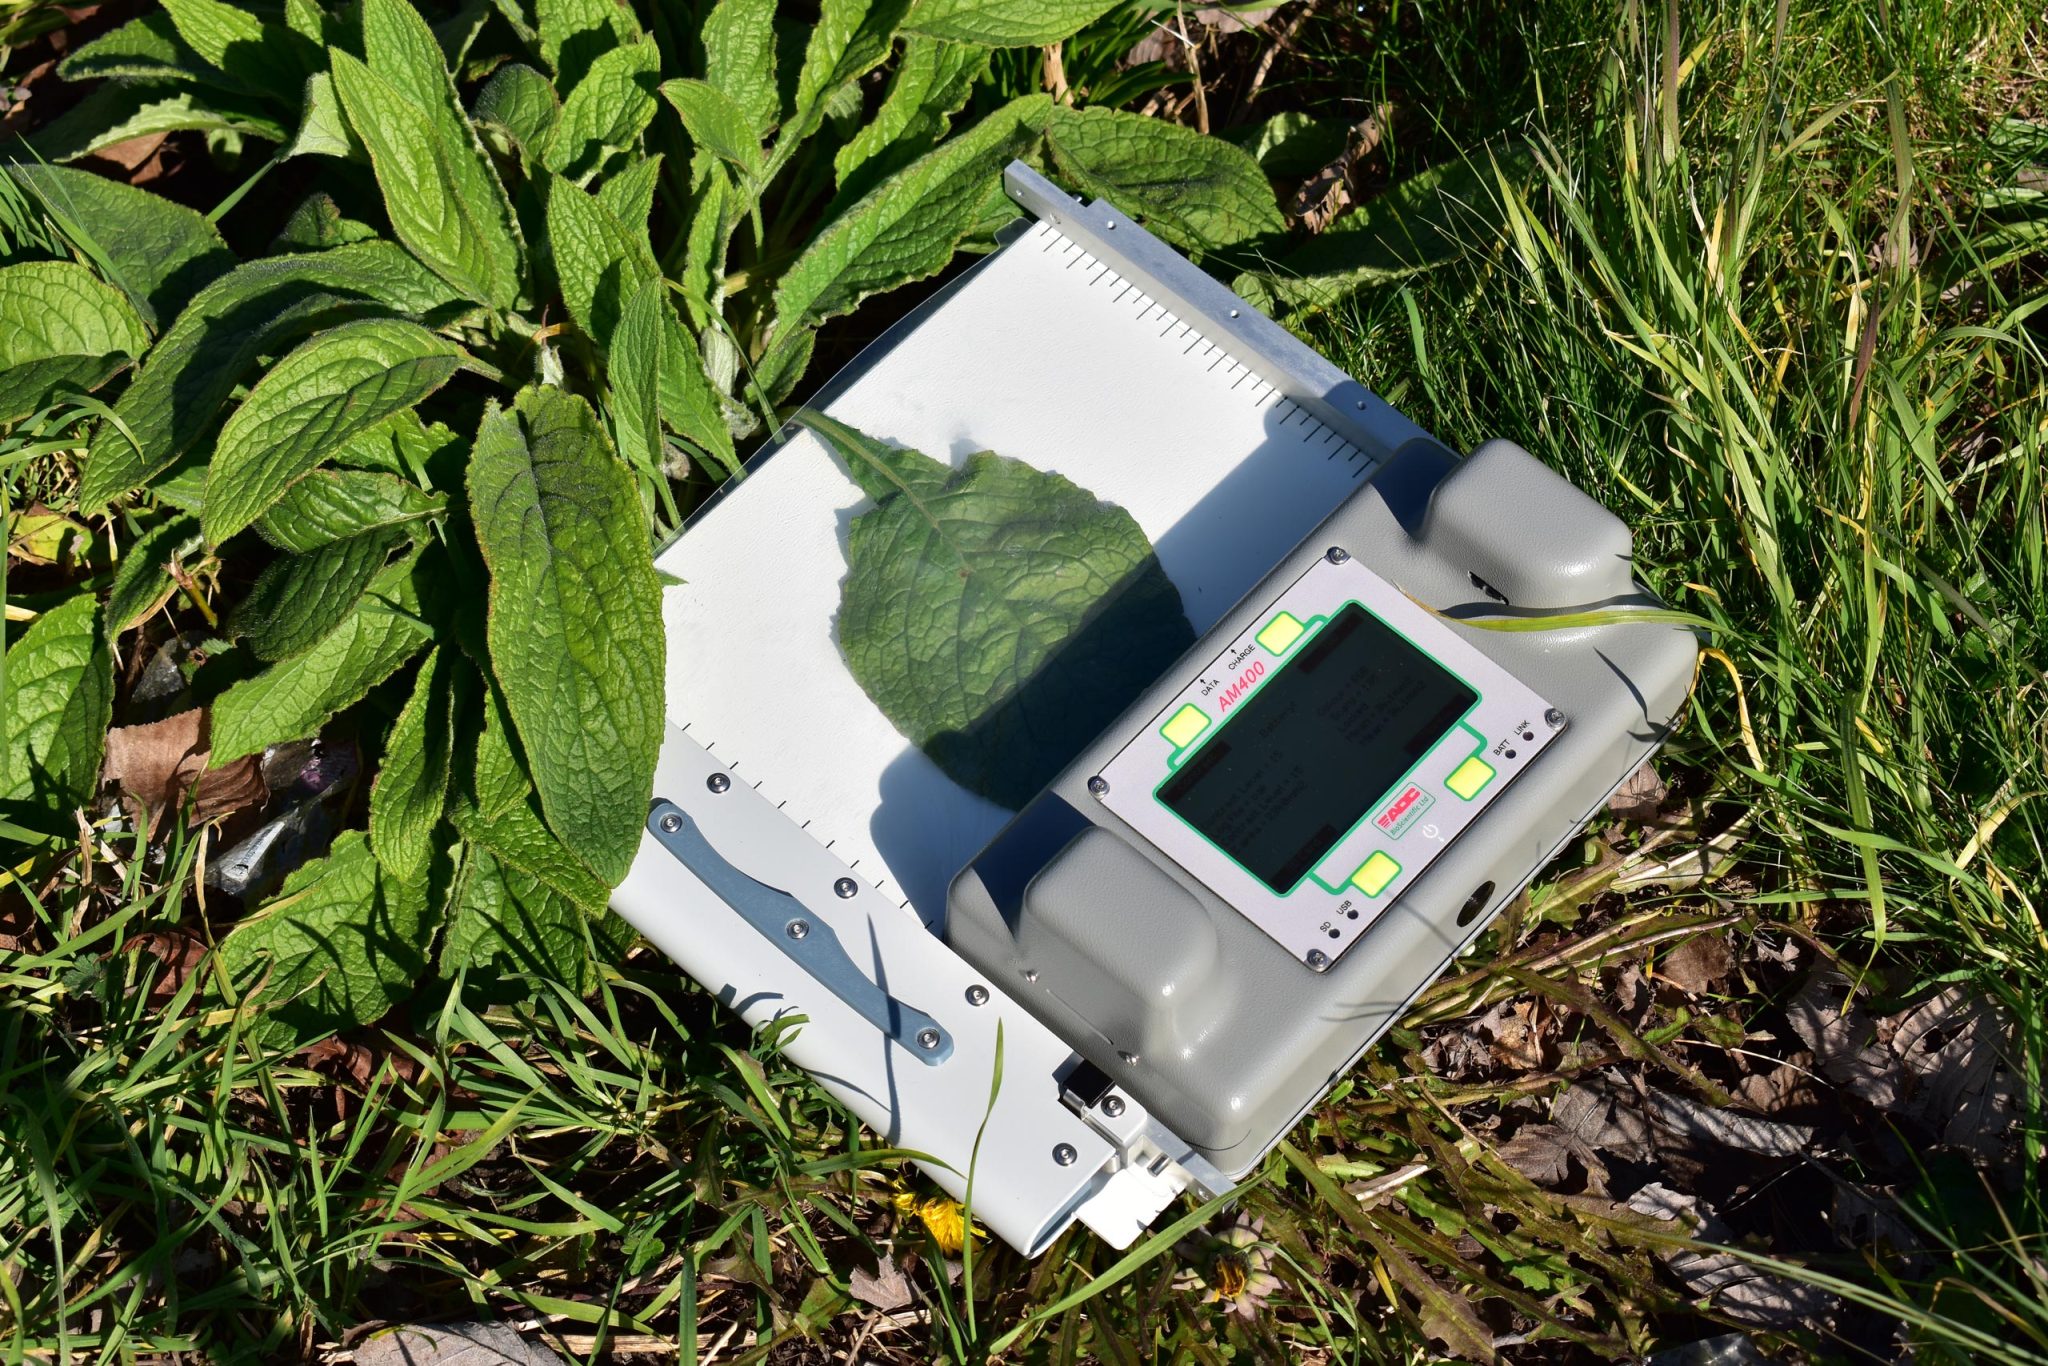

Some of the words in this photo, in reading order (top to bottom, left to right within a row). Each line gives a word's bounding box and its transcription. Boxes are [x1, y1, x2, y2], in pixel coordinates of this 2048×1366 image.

[1228, 644, 1256, 671] CHARGE
[1201, 679, 1220, 696] DATA
[1218, 661, 1265, 712] AM400
[1513, 720, 1530, 736] LINK
[1493, 739, 1511, 756] BATT
[1336, 900, 1352, 915] USB
[1320, 921, 1332, 933] SD
